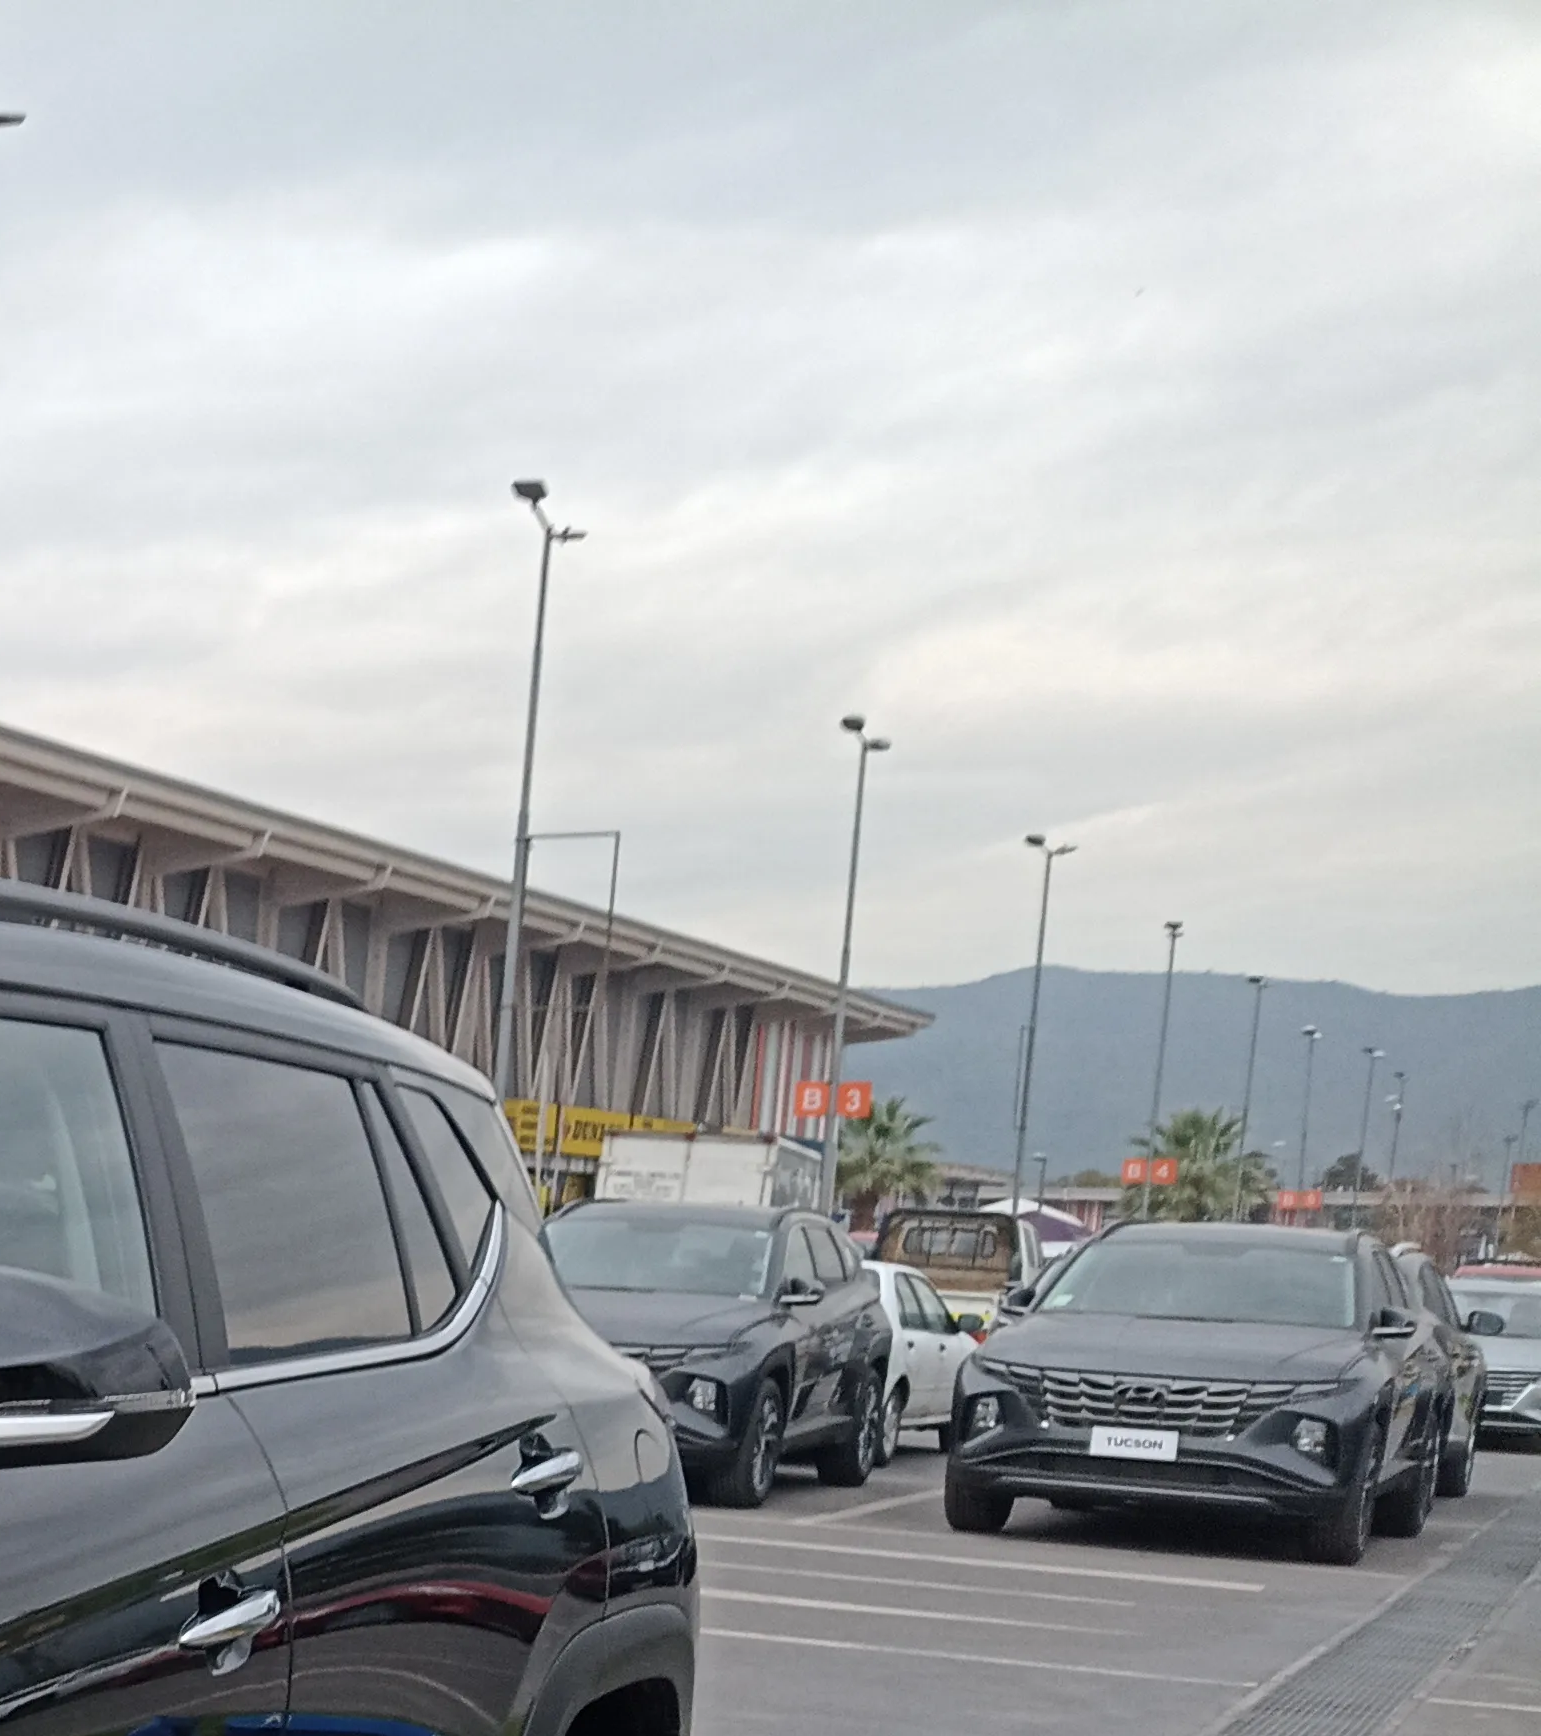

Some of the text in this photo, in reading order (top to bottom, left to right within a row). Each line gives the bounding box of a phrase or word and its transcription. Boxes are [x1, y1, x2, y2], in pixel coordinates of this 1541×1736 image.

[801, 1085, 862, 1113] B 3
[1106, 1435, 1164, 1450] TUCSON
